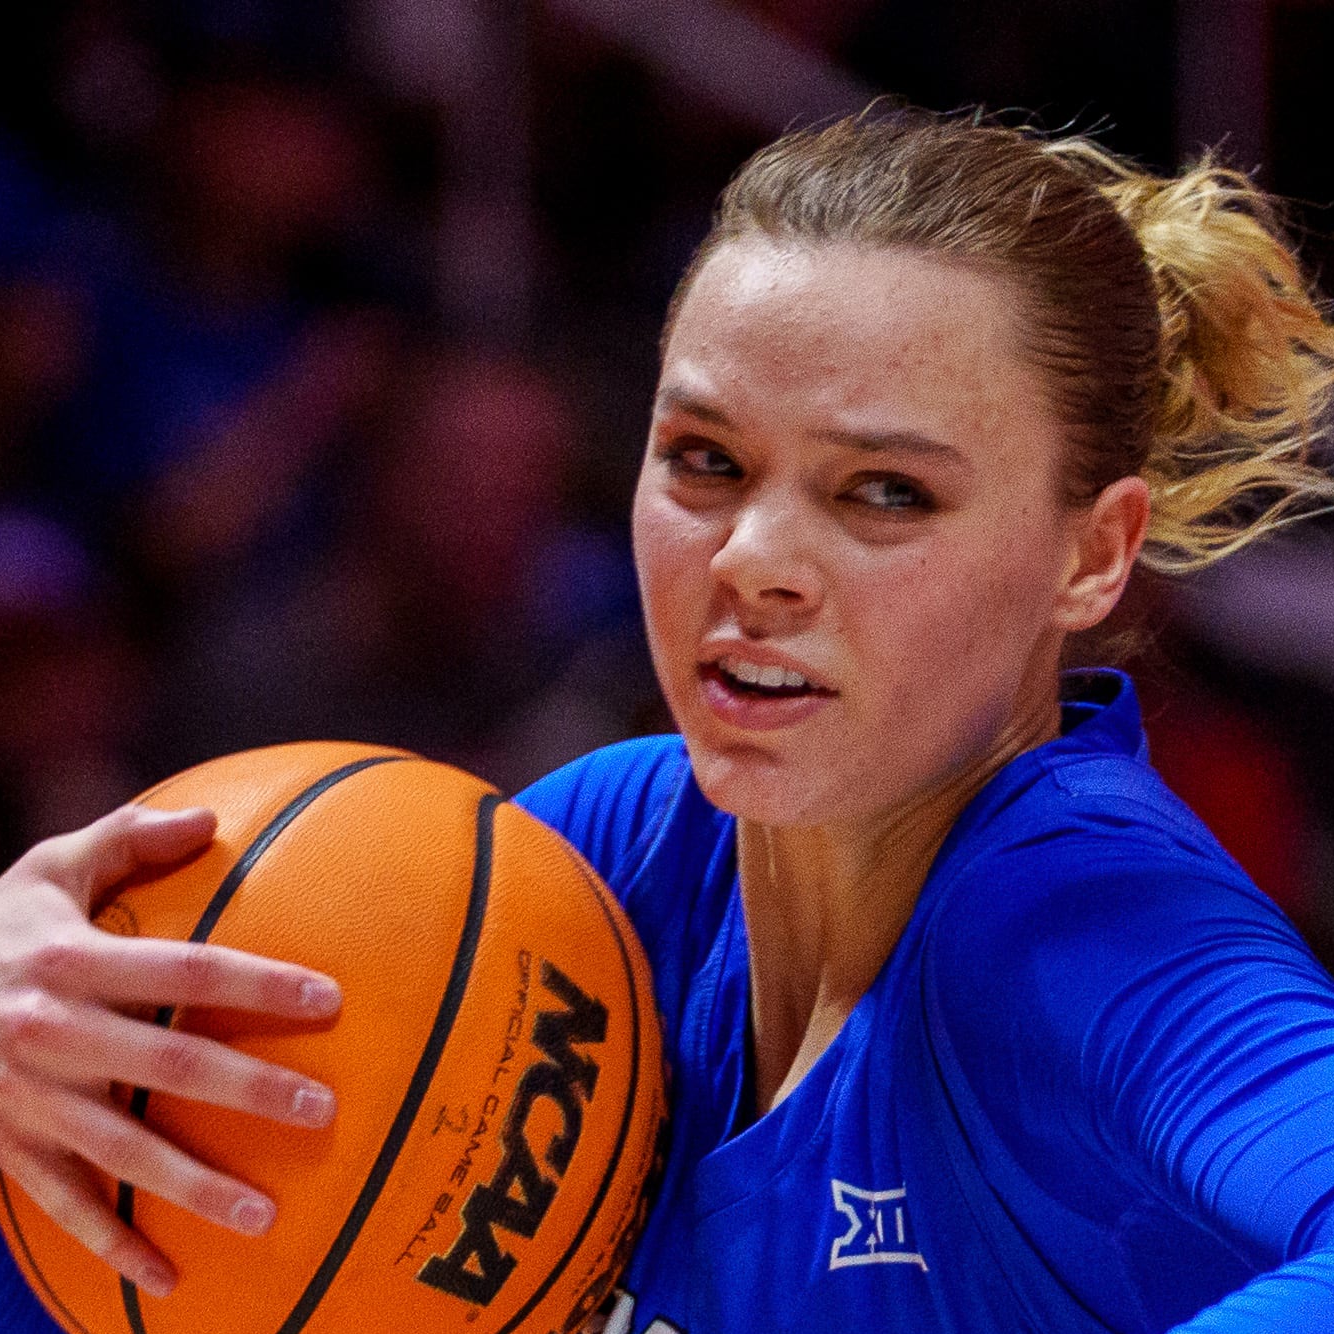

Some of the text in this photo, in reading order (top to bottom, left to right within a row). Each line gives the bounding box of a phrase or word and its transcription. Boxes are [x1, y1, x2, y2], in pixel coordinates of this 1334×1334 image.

[394, 948, 532, 1267] OFFICIAL GAME BALL
[414, 957, 610, 1307] NCAA
